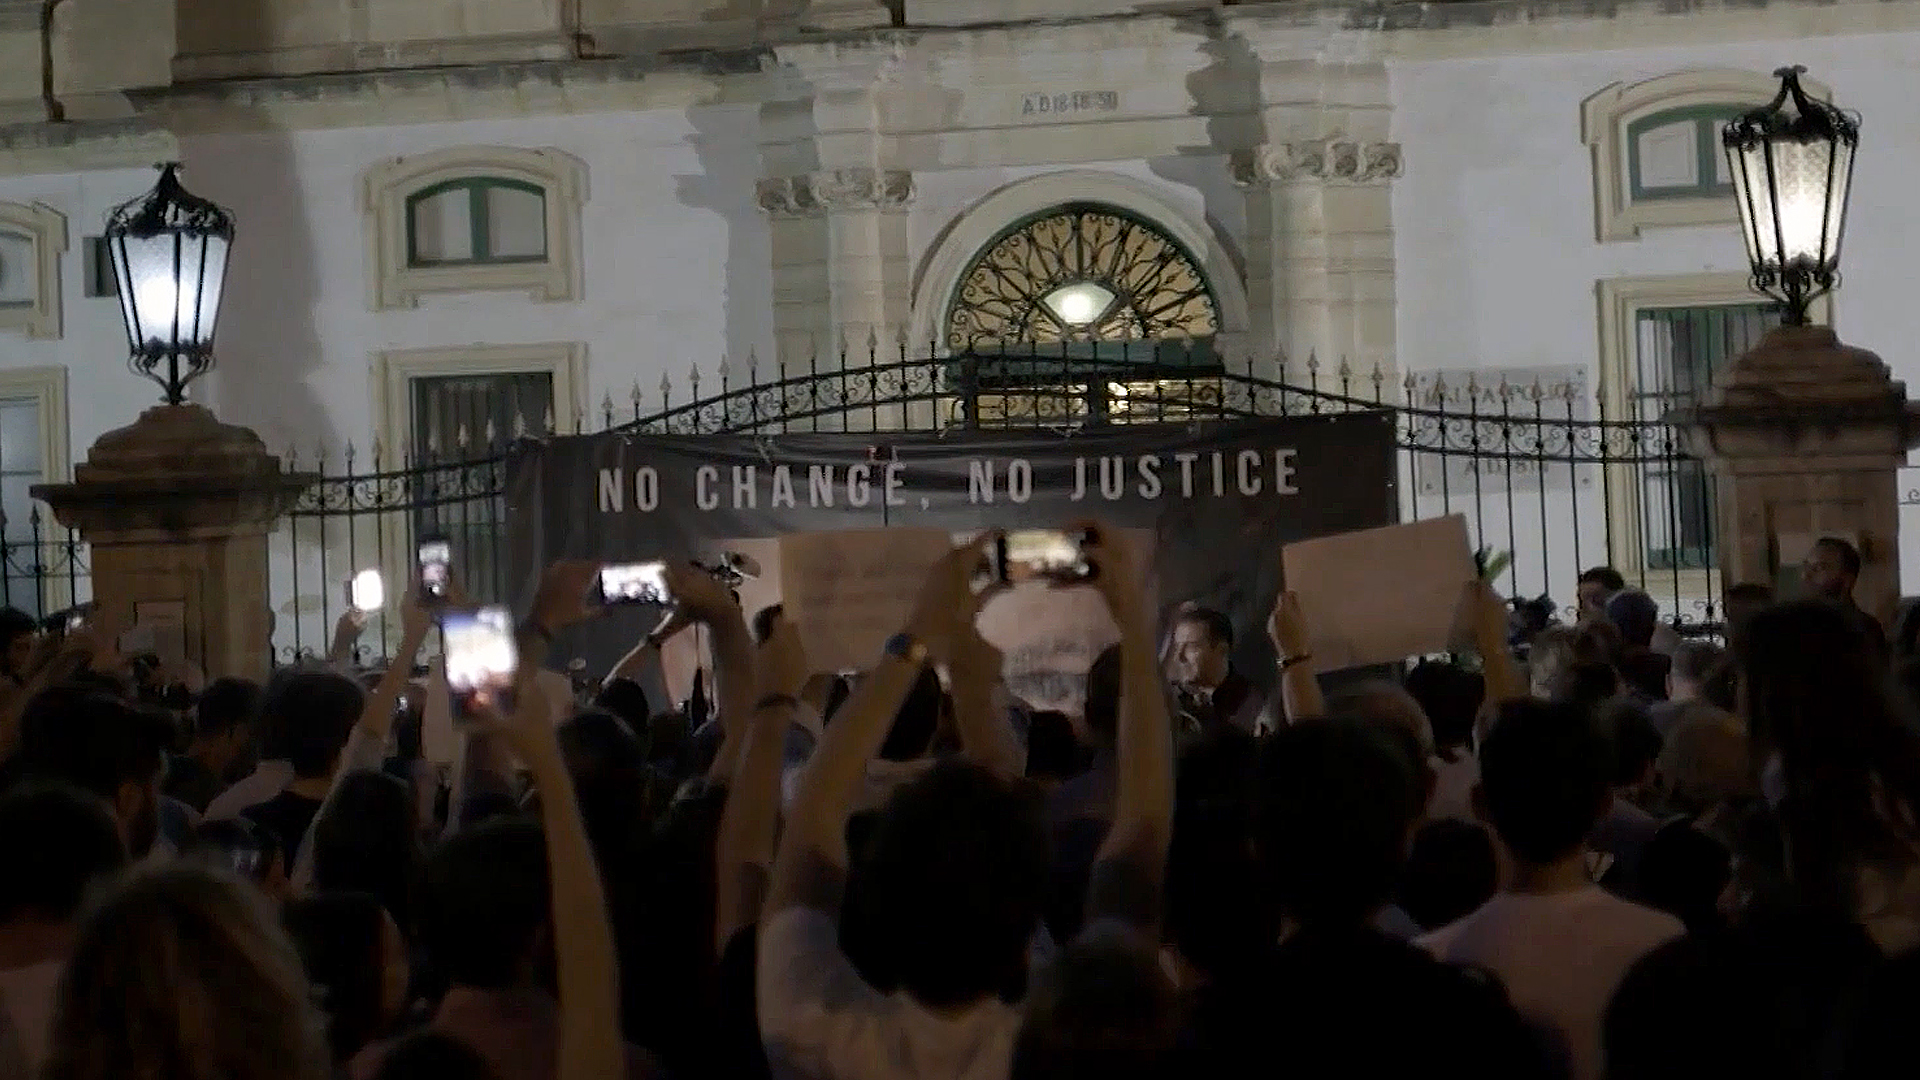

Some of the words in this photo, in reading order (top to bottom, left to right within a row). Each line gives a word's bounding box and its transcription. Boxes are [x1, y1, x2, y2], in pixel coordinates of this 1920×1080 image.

[599, 465, 660, 512] NO
[696, 463, 930, 511] CHANGE,
[968, 458, 1033, 504] NO
[1070, 448, 1300, 502] JUSTICE
